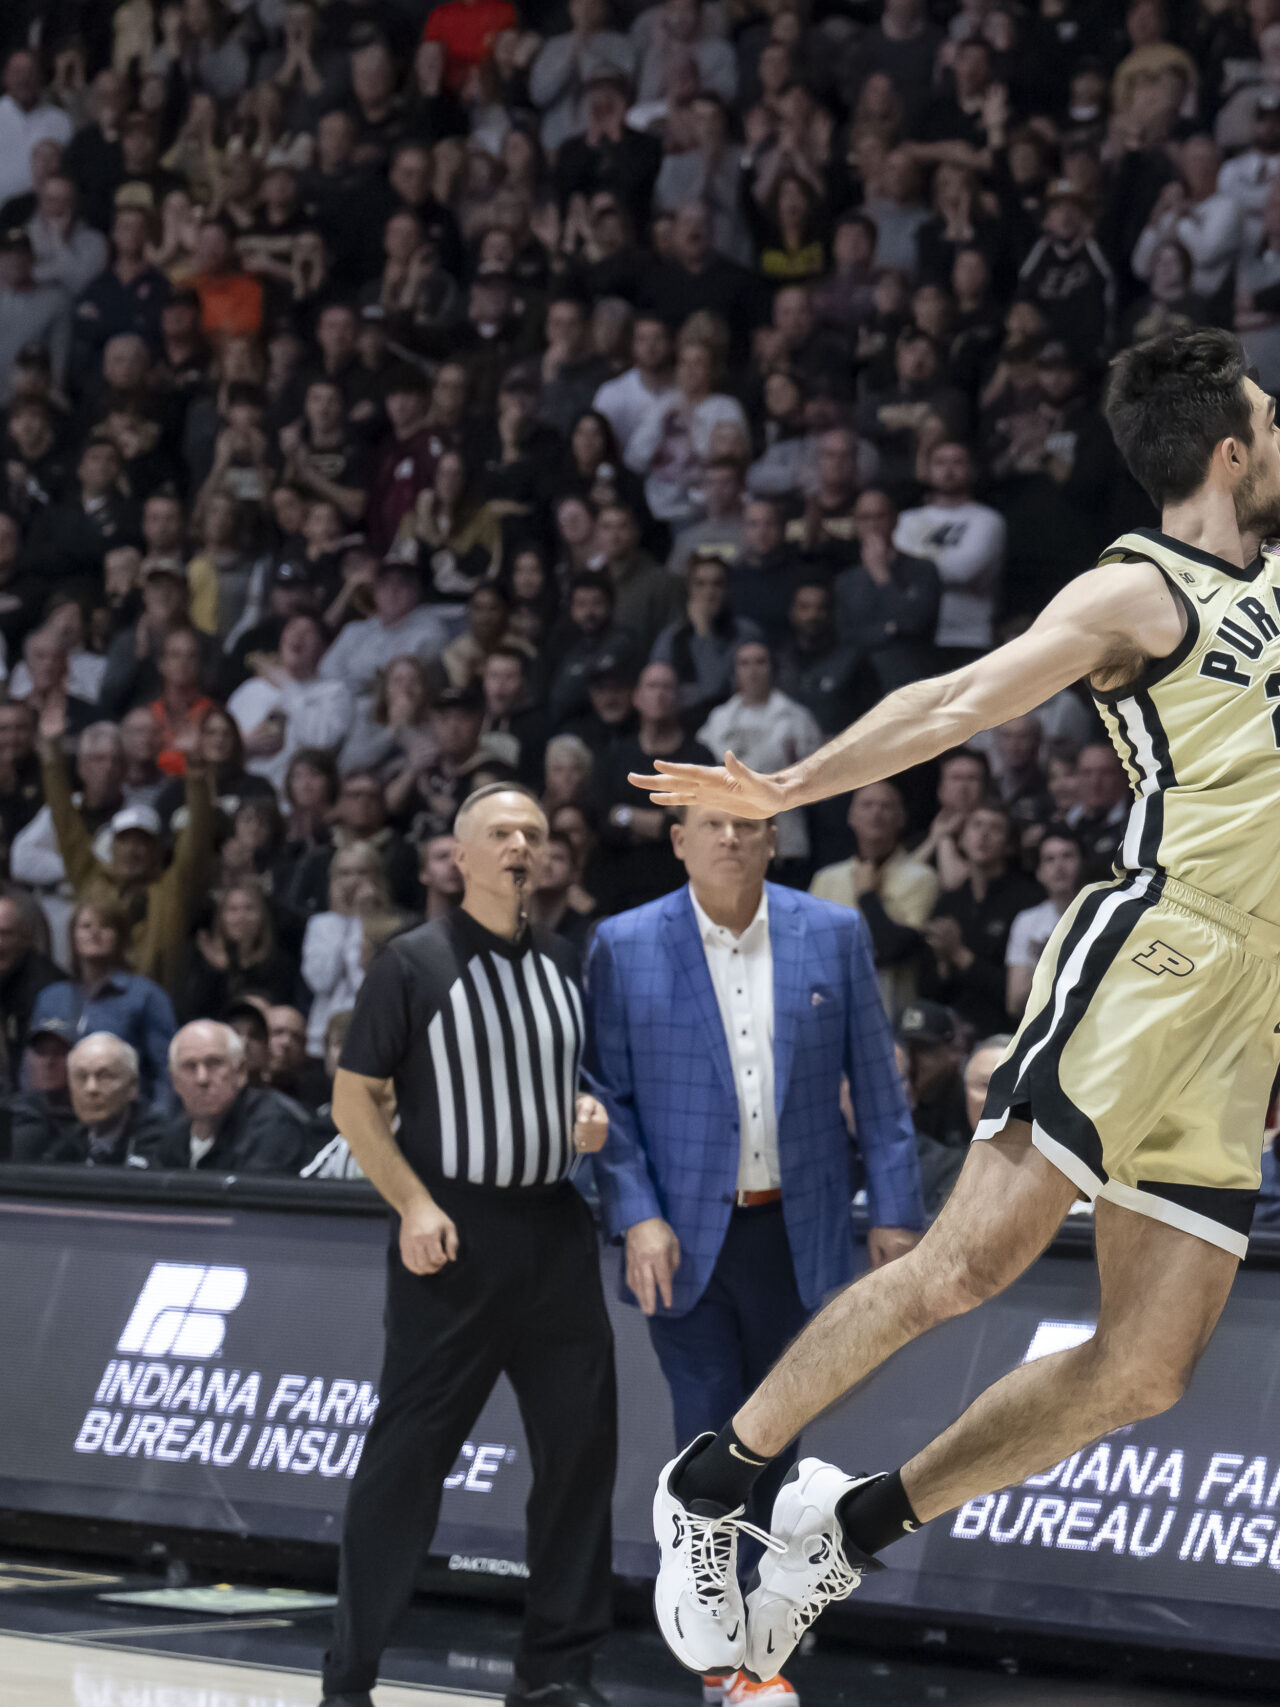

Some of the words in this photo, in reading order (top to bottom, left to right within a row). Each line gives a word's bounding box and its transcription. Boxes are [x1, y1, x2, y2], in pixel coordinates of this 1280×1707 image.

[1131, 940, 1195, 977] P
[95, 1359, 261, 1419] INDIANA
[74, 1410, 251, 1466] BUREAU
[951, 1492, 1176, 1558] BUREAU
